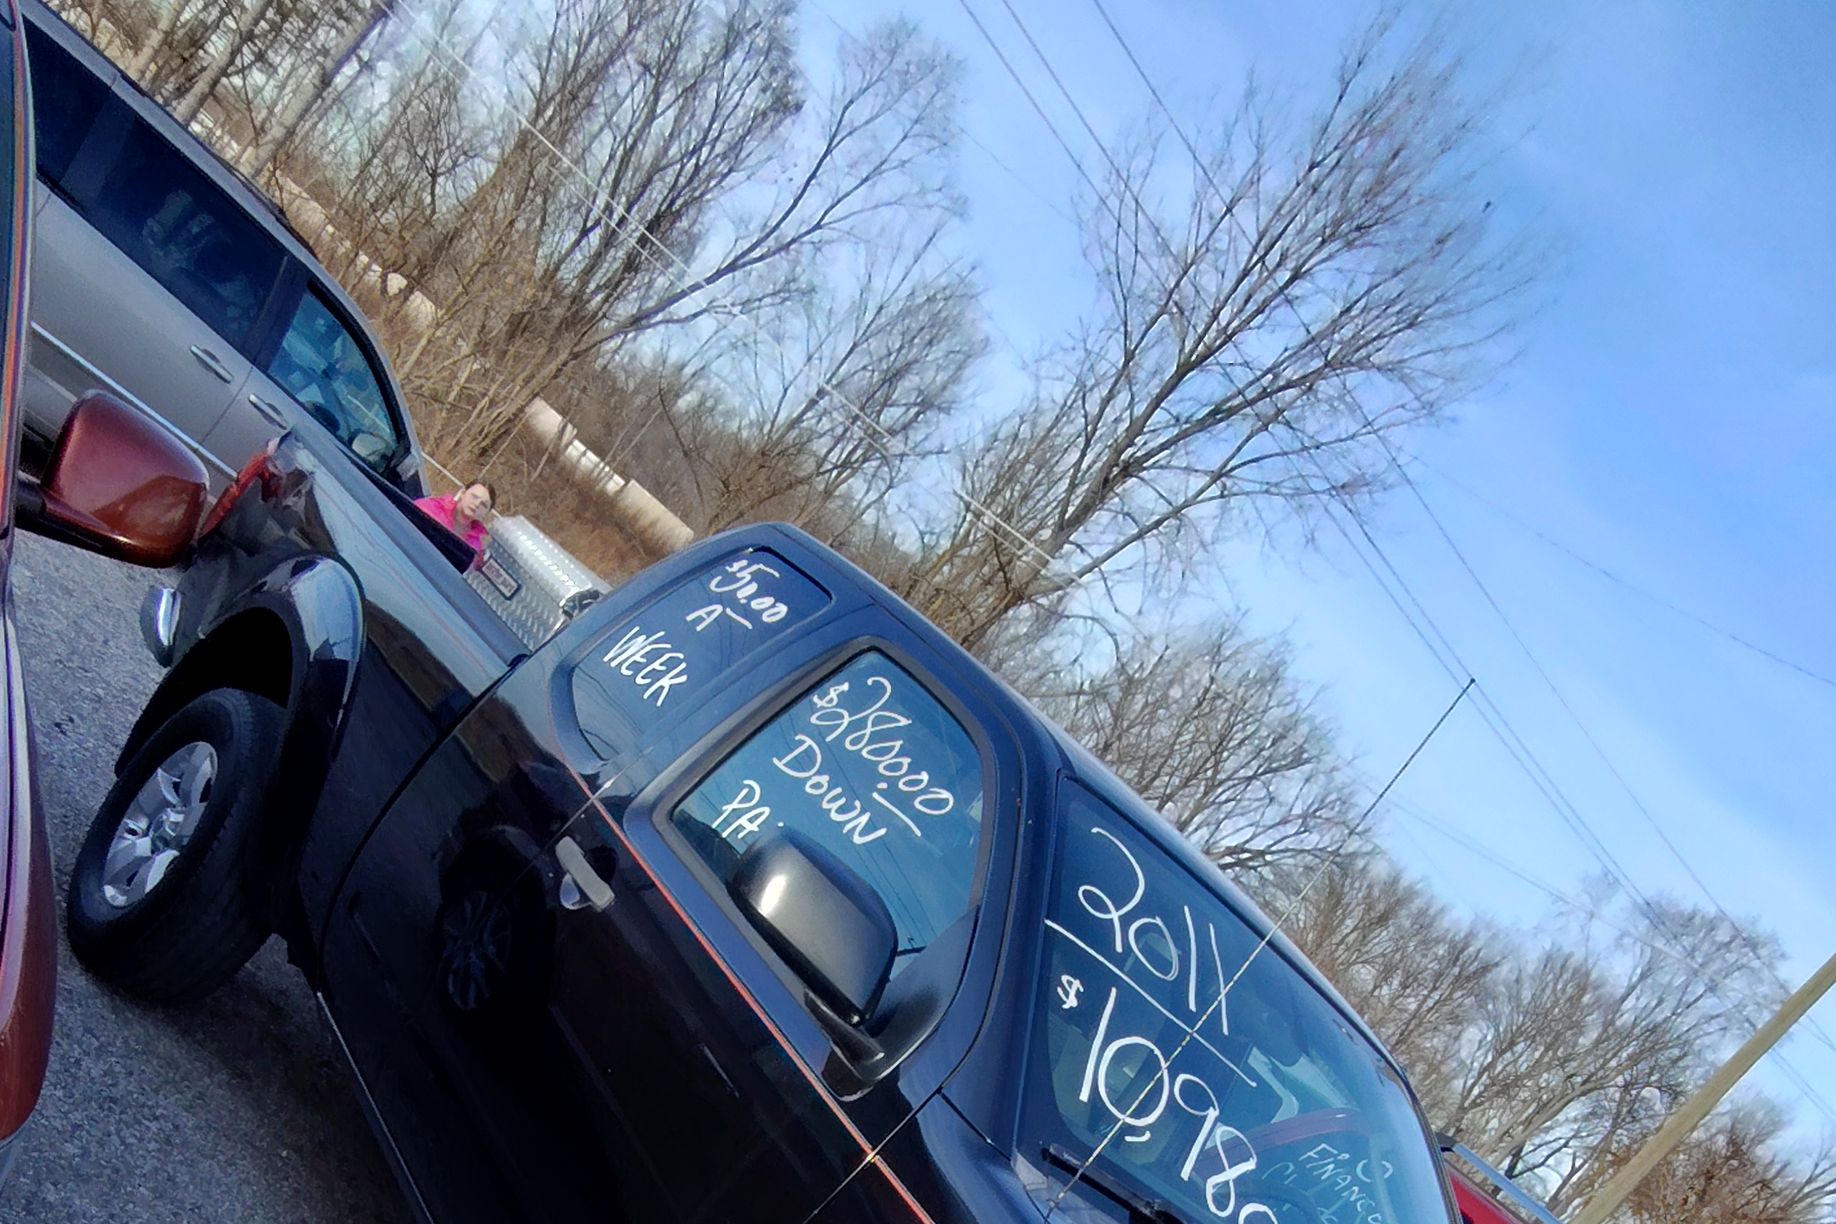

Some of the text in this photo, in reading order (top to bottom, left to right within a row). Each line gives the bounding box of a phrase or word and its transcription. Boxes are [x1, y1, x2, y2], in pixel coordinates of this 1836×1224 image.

[685, 603, 724, 632] A
[710, 559, 789, 624] $50.00
[602, 625, 688, 708] WEEK
[711, 779, 785, 840] PA
[772, 733, 888, 846] DOWN
[1077, 826, 1230, 1036] 2011
